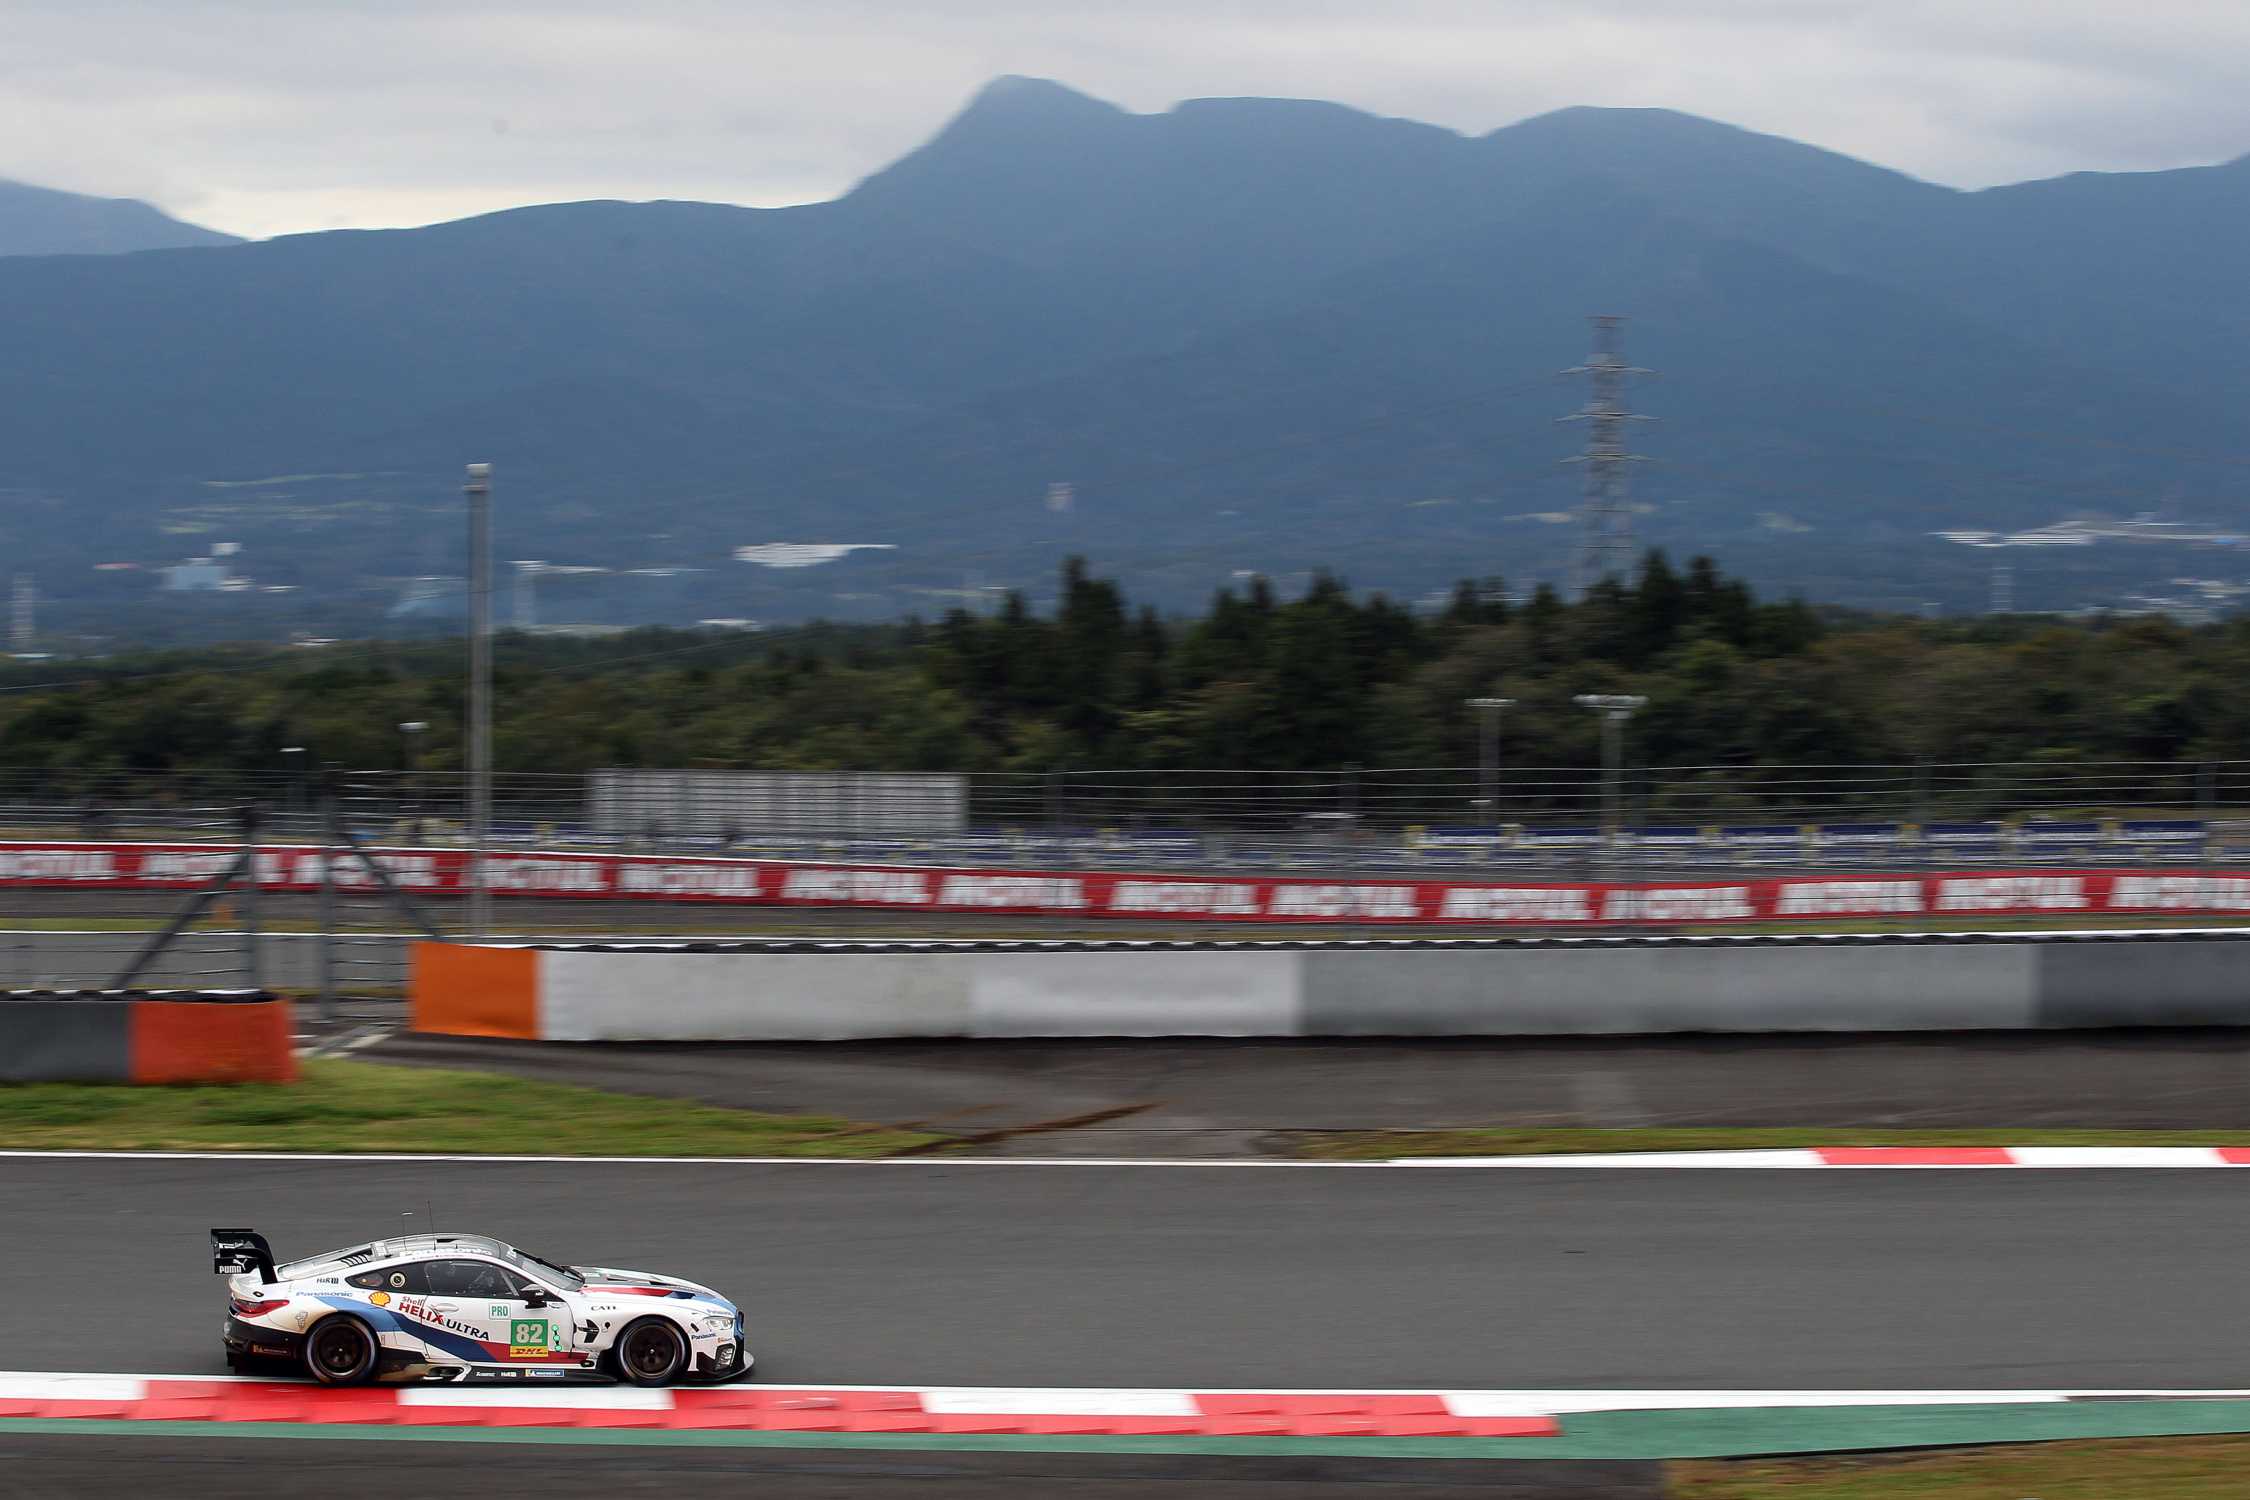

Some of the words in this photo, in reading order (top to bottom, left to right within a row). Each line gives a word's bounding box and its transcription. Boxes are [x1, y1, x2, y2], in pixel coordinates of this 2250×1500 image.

[219, 1265, 242, 1274] PUMA
[402, 1295, 424, 1306] Shell
[491, 1305, 509, 1317] PRO
[399, 1301, 446, 1326] HELIX
[446, 1318, 490, 1341] ULTRA
[516, 1323, 543, 1344] 82
